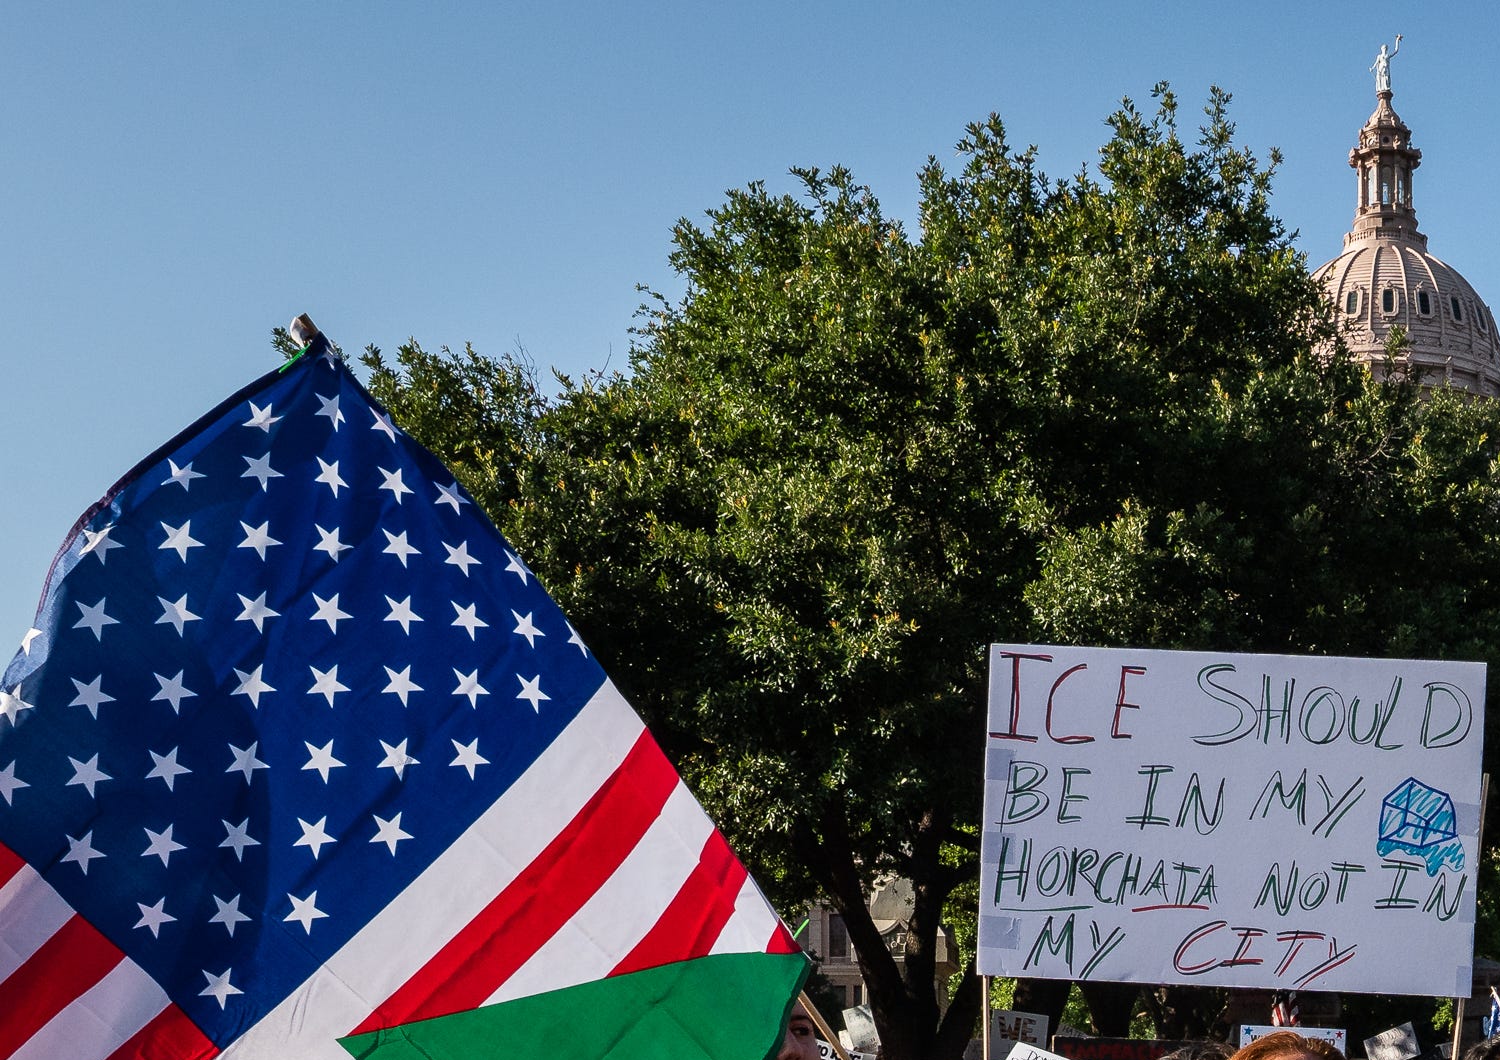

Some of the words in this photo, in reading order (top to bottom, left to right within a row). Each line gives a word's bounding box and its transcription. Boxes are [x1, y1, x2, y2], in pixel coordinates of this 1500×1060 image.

[989, 651, 1147, 744] ICE
[1191, 663, 1473, 750] SHOULD
[995, 760, 1092, 831] BE
[1126, 765, 1226, 835] IN
[1249, 768, 1365, 837] MY
[994, 837, 1218, 908] HORCHATA
[1254, 860, 1366, 915] NOT
[1374, 859, 1468, 921] IN
[1023, 914, 1126, 979] MY
[1173, 921, 1358, 988] CITY
